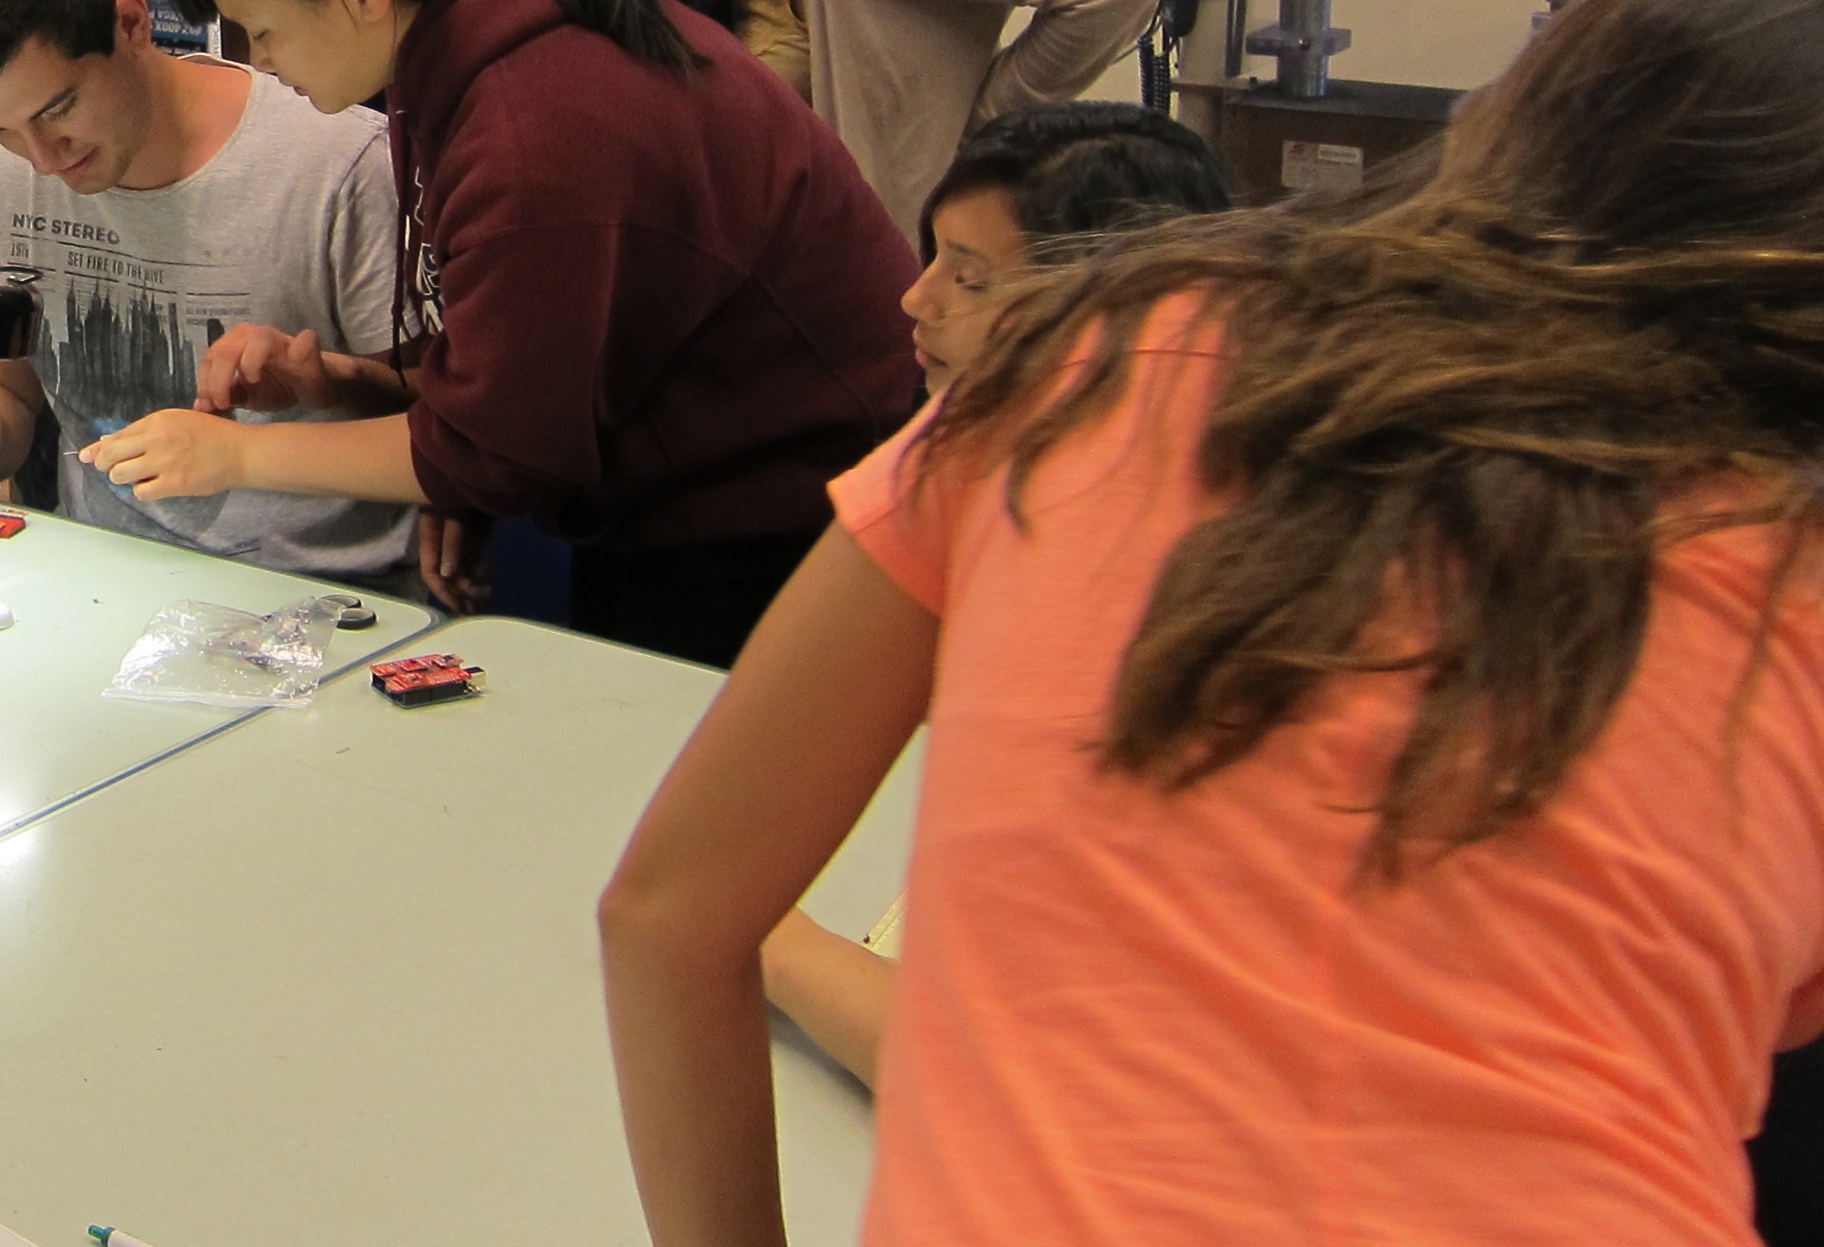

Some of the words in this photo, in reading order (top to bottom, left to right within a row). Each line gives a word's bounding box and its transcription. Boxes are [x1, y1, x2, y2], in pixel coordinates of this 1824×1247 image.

[12, 213, 46, 232] NYC
[51, 220, 120, 245] STEREO
[68, 251, 83, 268] SET
[87, 255, 108, 272] FIRE
[112, 259, 124, 275] TO
[127, 262, 142, 280] THE
